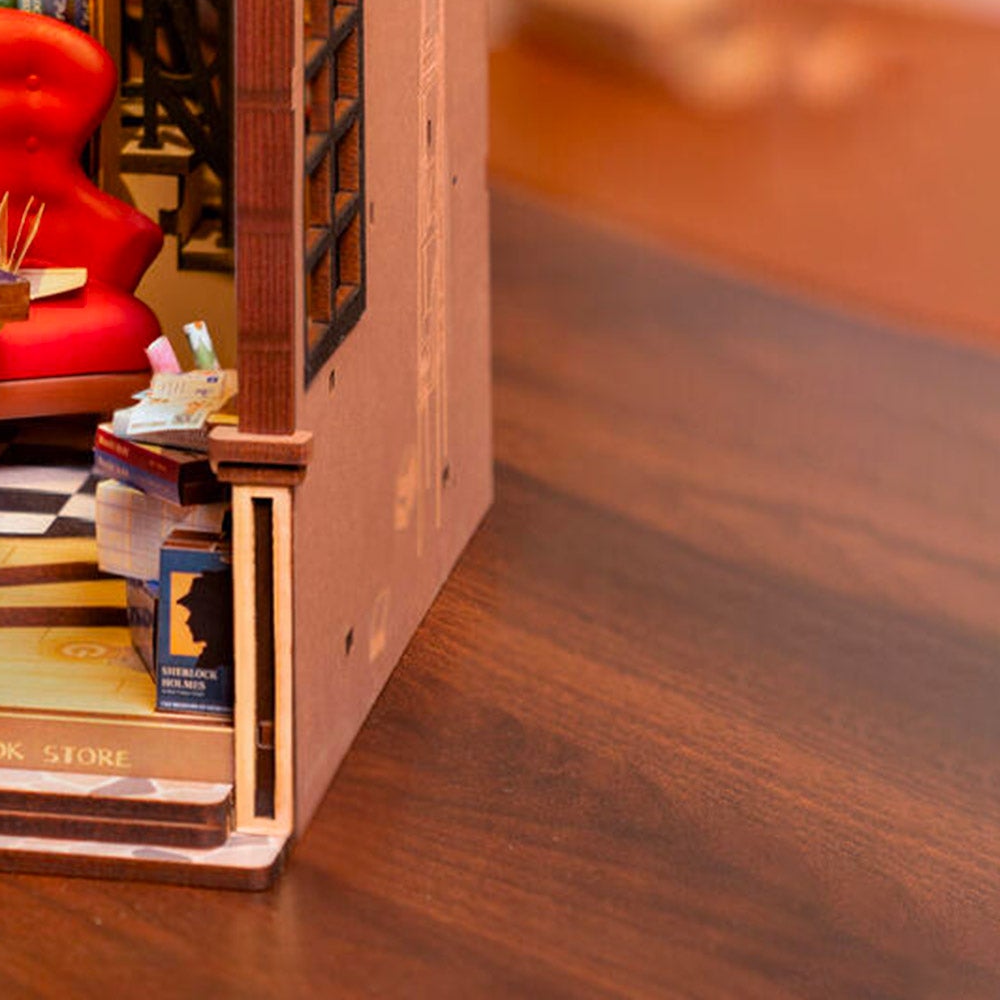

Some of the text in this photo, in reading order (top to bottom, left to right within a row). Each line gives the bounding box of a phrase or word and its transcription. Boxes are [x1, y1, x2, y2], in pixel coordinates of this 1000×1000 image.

[160, 665, 218, 681] SHERLOCK
[160, 678, 207, 691] HOLMES
[43, 744, 132, 769] STORE
